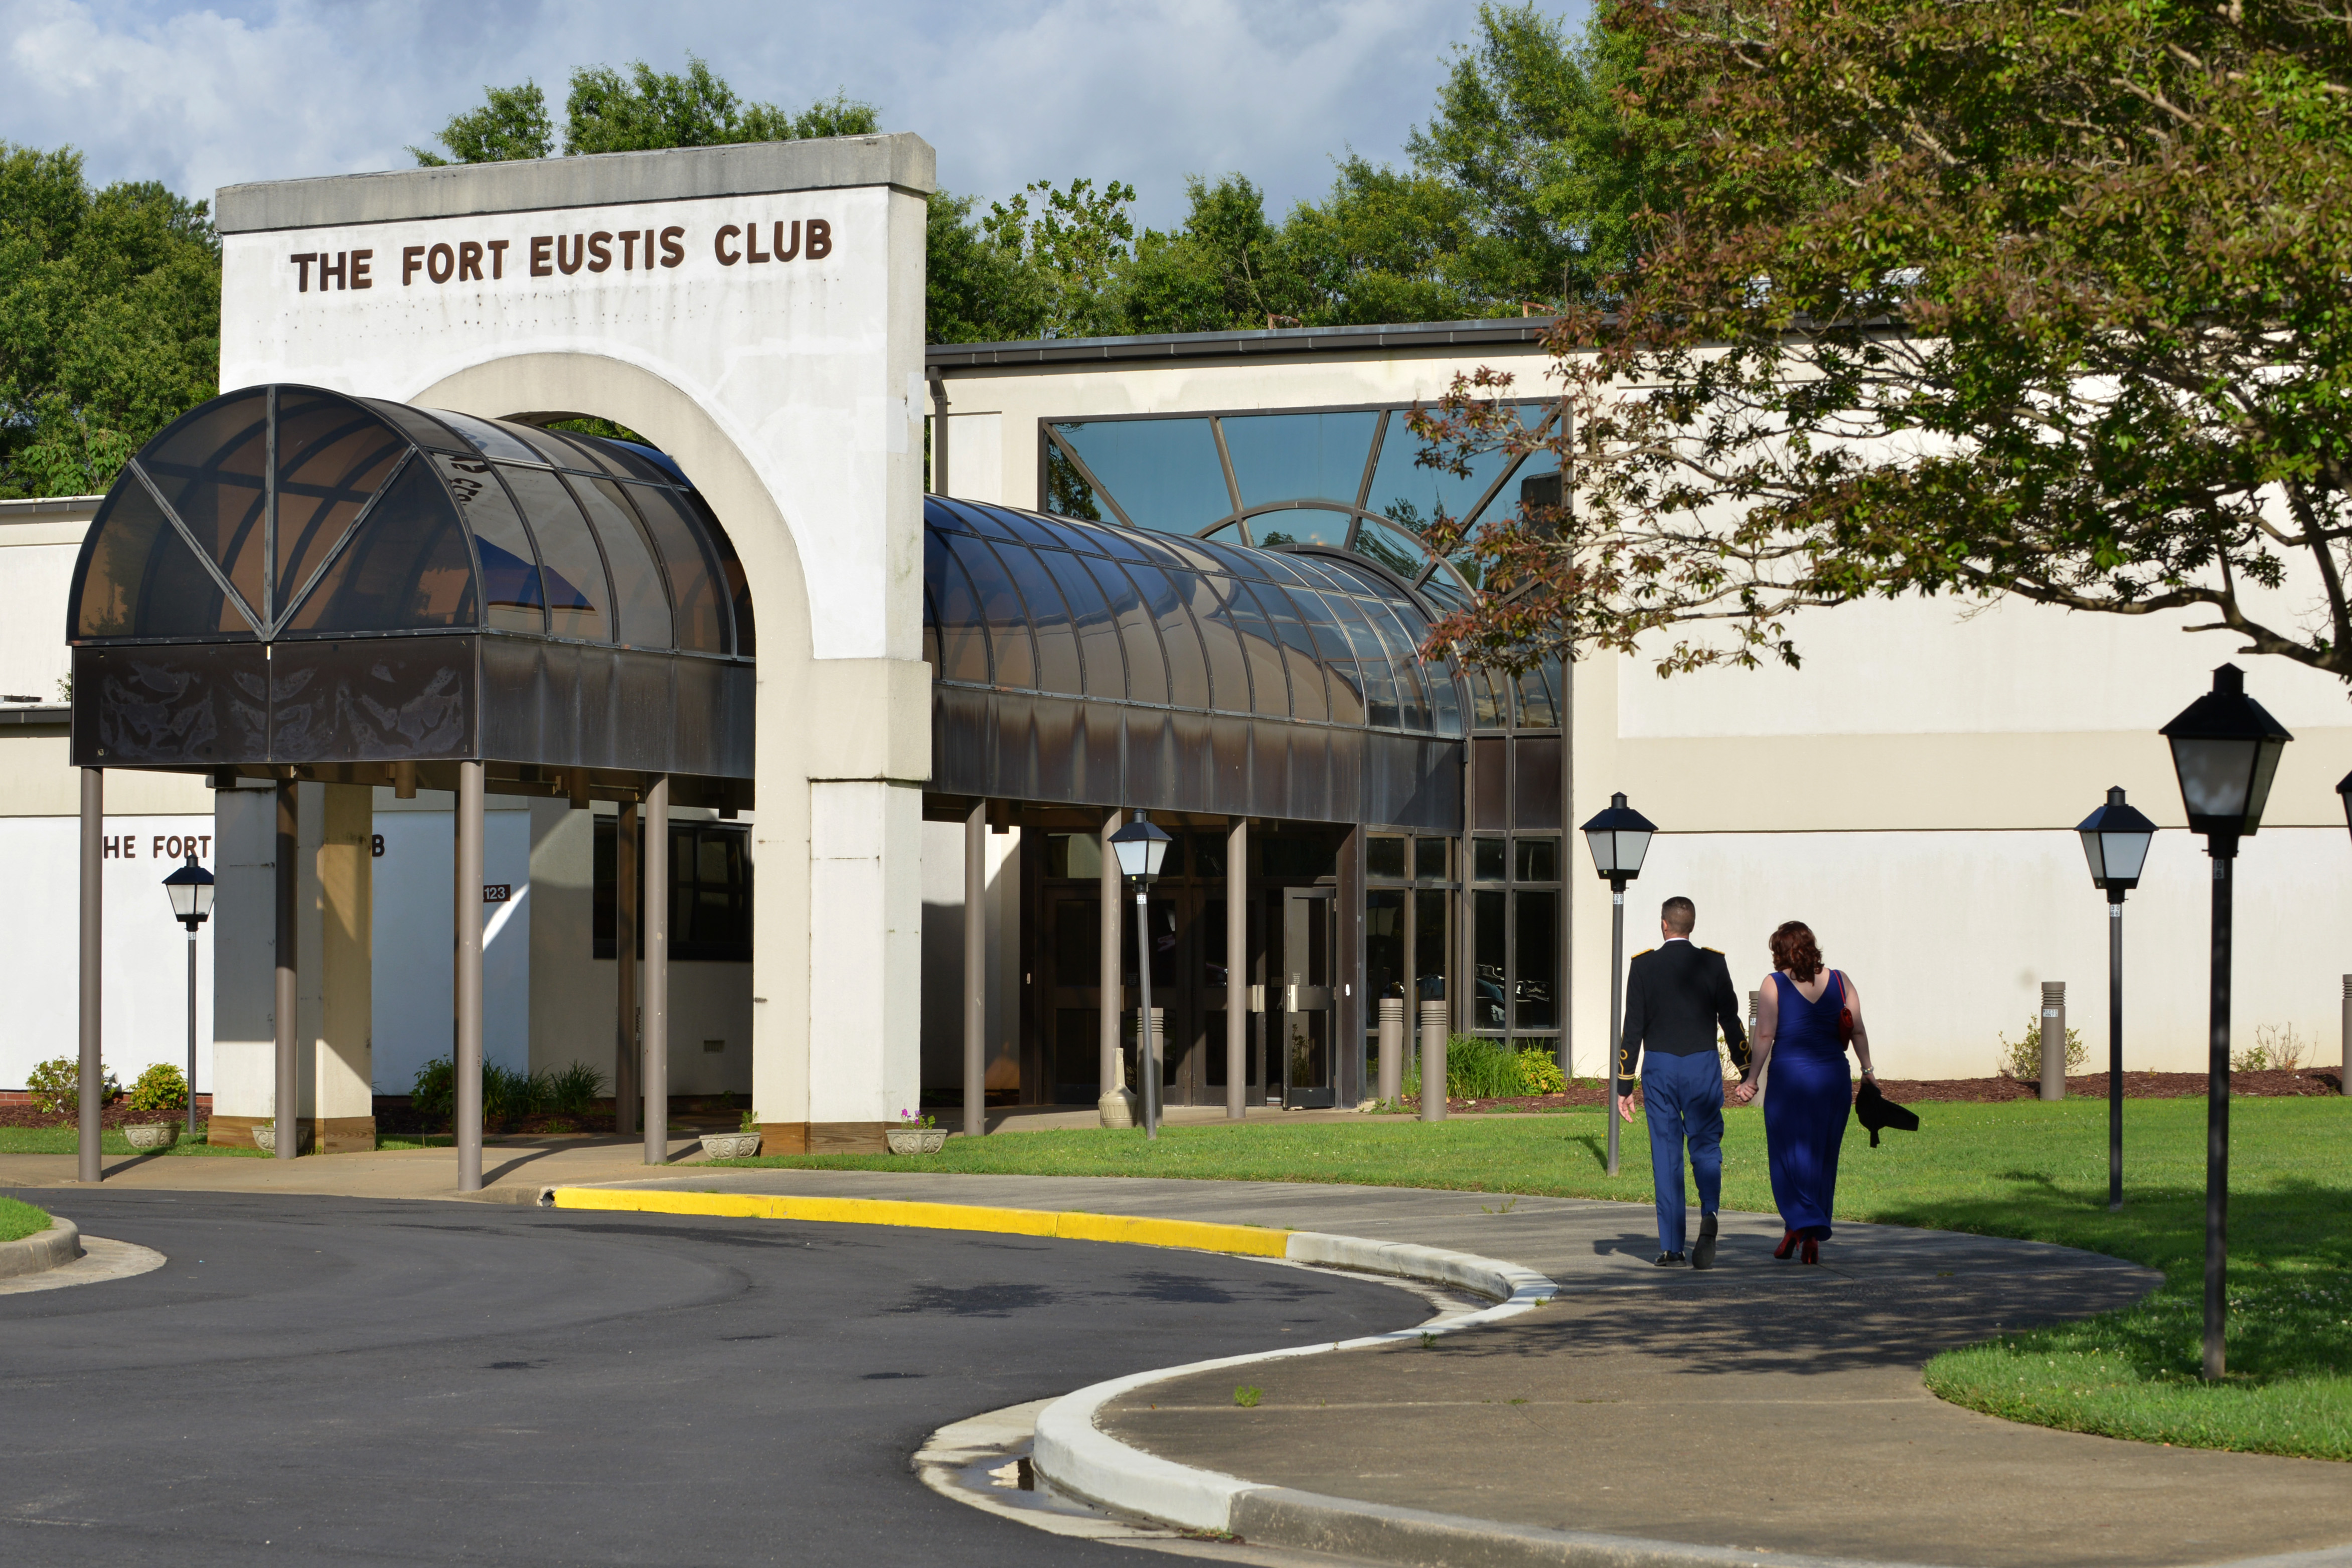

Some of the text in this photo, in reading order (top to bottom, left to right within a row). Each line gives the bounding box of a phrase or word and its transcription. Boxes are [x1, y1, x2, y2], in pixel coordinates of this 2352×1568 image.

[290, 219, 832, 292] THE FORT EUSTIS CLUB
[103, 835, 211, 859] HE FORT
[483, 886, 506, 899] 123
